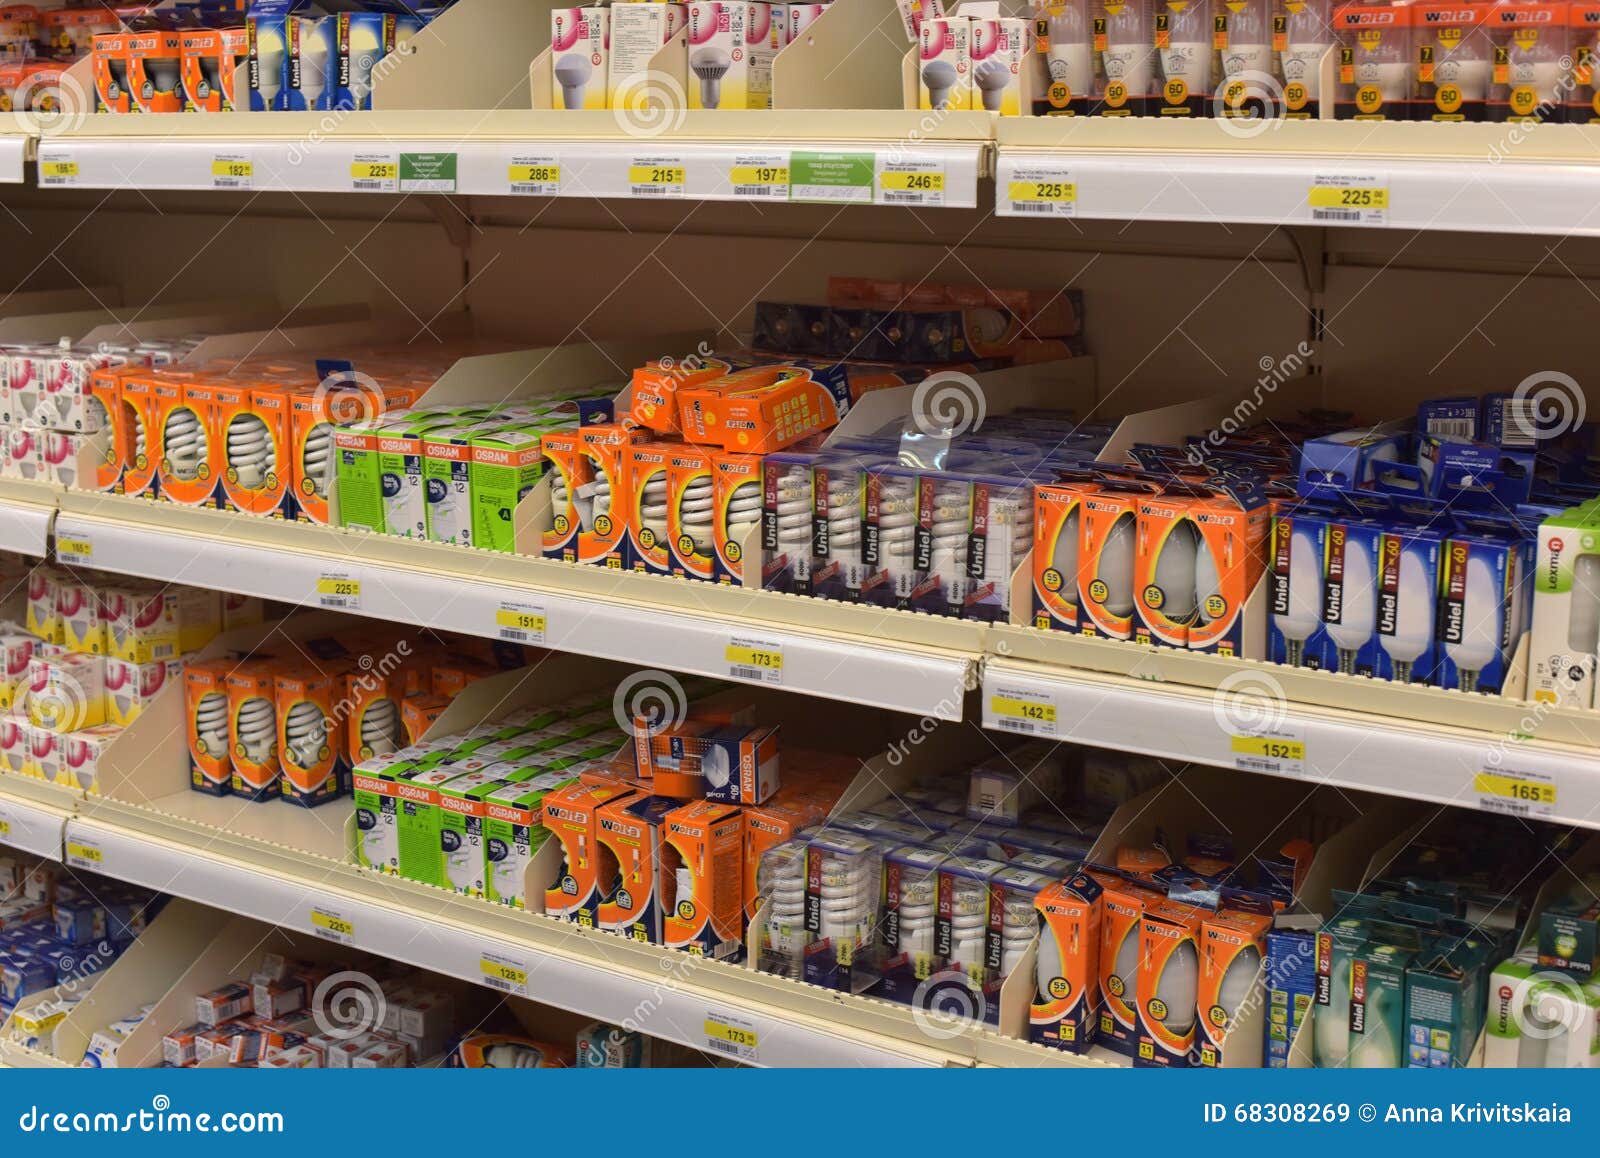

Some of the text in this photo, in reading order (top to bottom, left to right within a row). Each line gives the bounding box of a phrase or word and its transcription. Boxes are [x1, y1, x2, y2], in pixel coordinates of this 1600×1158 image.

[1358, 31, 1381, 41] LED
[1438, 29, 1461, 40] LED
[1514, 30, 1537, 40] LED
[251, 60, 259, 88] Uniel
[292, 59, 300, 87] Uniel
[340, 56, 349, 85] Uniel
[1052, 88, 1067, 98] 60
[1109, 86, 1123, 97] 60
[1168, 84, 1184, 95] 60
[1228, 87, 1242, 97] 60
[1287, 88, 1304, 99] 60
[1361, 91, 1377, 102] 60
[1441, 90, 1457, 101] 60
[1515, 92, 1533, 104] 60
[228, 165, 244, 176] 182
[369, 165, 387, 177] 225
[529, 168, 548, 181] 286
[652, 170, 673, 182] 215
[756, 168, 777, 181] 197
[907, 175, 931, 189] 246
[1037, 183, 1062, 198] 225
[1342, 190, 1371, 205] 225
[337, 437, 366, 448] OSRAM
[380, 441, 412, 452] OSRAM
[427, 446, 459, 457] OSRAM
[475, 451, 509, 463] OSRAM
[408, 475, 418, 486] 12
[455, 482, 465, 493] 12
[556, 520, 566, 528] 75
[597, 520, 608, 529] 75
[766, 491, 777, 547] Uniel 15
[817, 499, 828, 555] Uniel 15
[641, 533, 653, 543] 75
[867, 505, 878, 561] Uniel 15
[679, 539, 691, 549] 75
[918, 510, 930, 568] Uniel 15
[971, 515, 985, 574] Uniel 15
[727, 545, 738, 555] 75
[1275, 523, 1290, 611] Uniel 11 60
[1047, 573, 1058, 582] 55
[1327, 530, 1344, 620] Uniel 11 60
[335, 583, 352, 595] 225
[1093, 585, 1105, 594] 55
[1381, 540, 1400, 632] Uniel 11 60
[1147, 591, 1159, 600] 55
[1446, 547, 1467, 640] Uniel 11 60
[1209, 599, 1221, 608] 55
[518, 616, 534, 627] 151
[751, 652, 771, 666] 173
[1021, 705, 1044, 720] 142
[1262, 743, 1289, 759] 152
[742, 755, 753, 793] OSRAM
[356, 778, 387, 792] OSRAM
[398, 786, 429, 800] OSRAM
[706, 791, 726, 799] SPOT
[1510, 785, 1540, 801] 165
[441, 797, 473, 812] OSRAM
[488, 805, 521, 820] OSRAM
[384, 814, 393, 825] 12
[469, 836, 479, 847] 12
[516, 845, 526, 856] 12
[681, 904, 692, 914] 75
[808, 877, 820, 930] Uniel 15
[580, 917, 592, 927] 15
[887, 892, 899, 945] Uniel 15
[328, 919, 344, 932] 225
[939, 901, 951, 955] Uniel 15
[635, 932, 646, 942] 15
[990, 912, 1002, 967] Uniel 15
[500, 967, 516, 980] 128
[1053, 981, 1066, 990] 55
[1110, 978, 1122, 988] 55
[1319, 976, 1329, 1003] Uniel
[1354, 987, 1364, 999] 42
[1151, 1002, 1164, 1013] 55
[1213, 1009, 1225, 1020] 55
[1353, 1003, 1364, 1032] Uniel
[1103, 1020, 1112, 1029] 11
[727, 1029, 745, 1043] 173
[1062, 1027, 1074, 1036] 11
[1141, 1045, 1152, 1055] 11
[1204, 1052, 1214, 1062] 11
